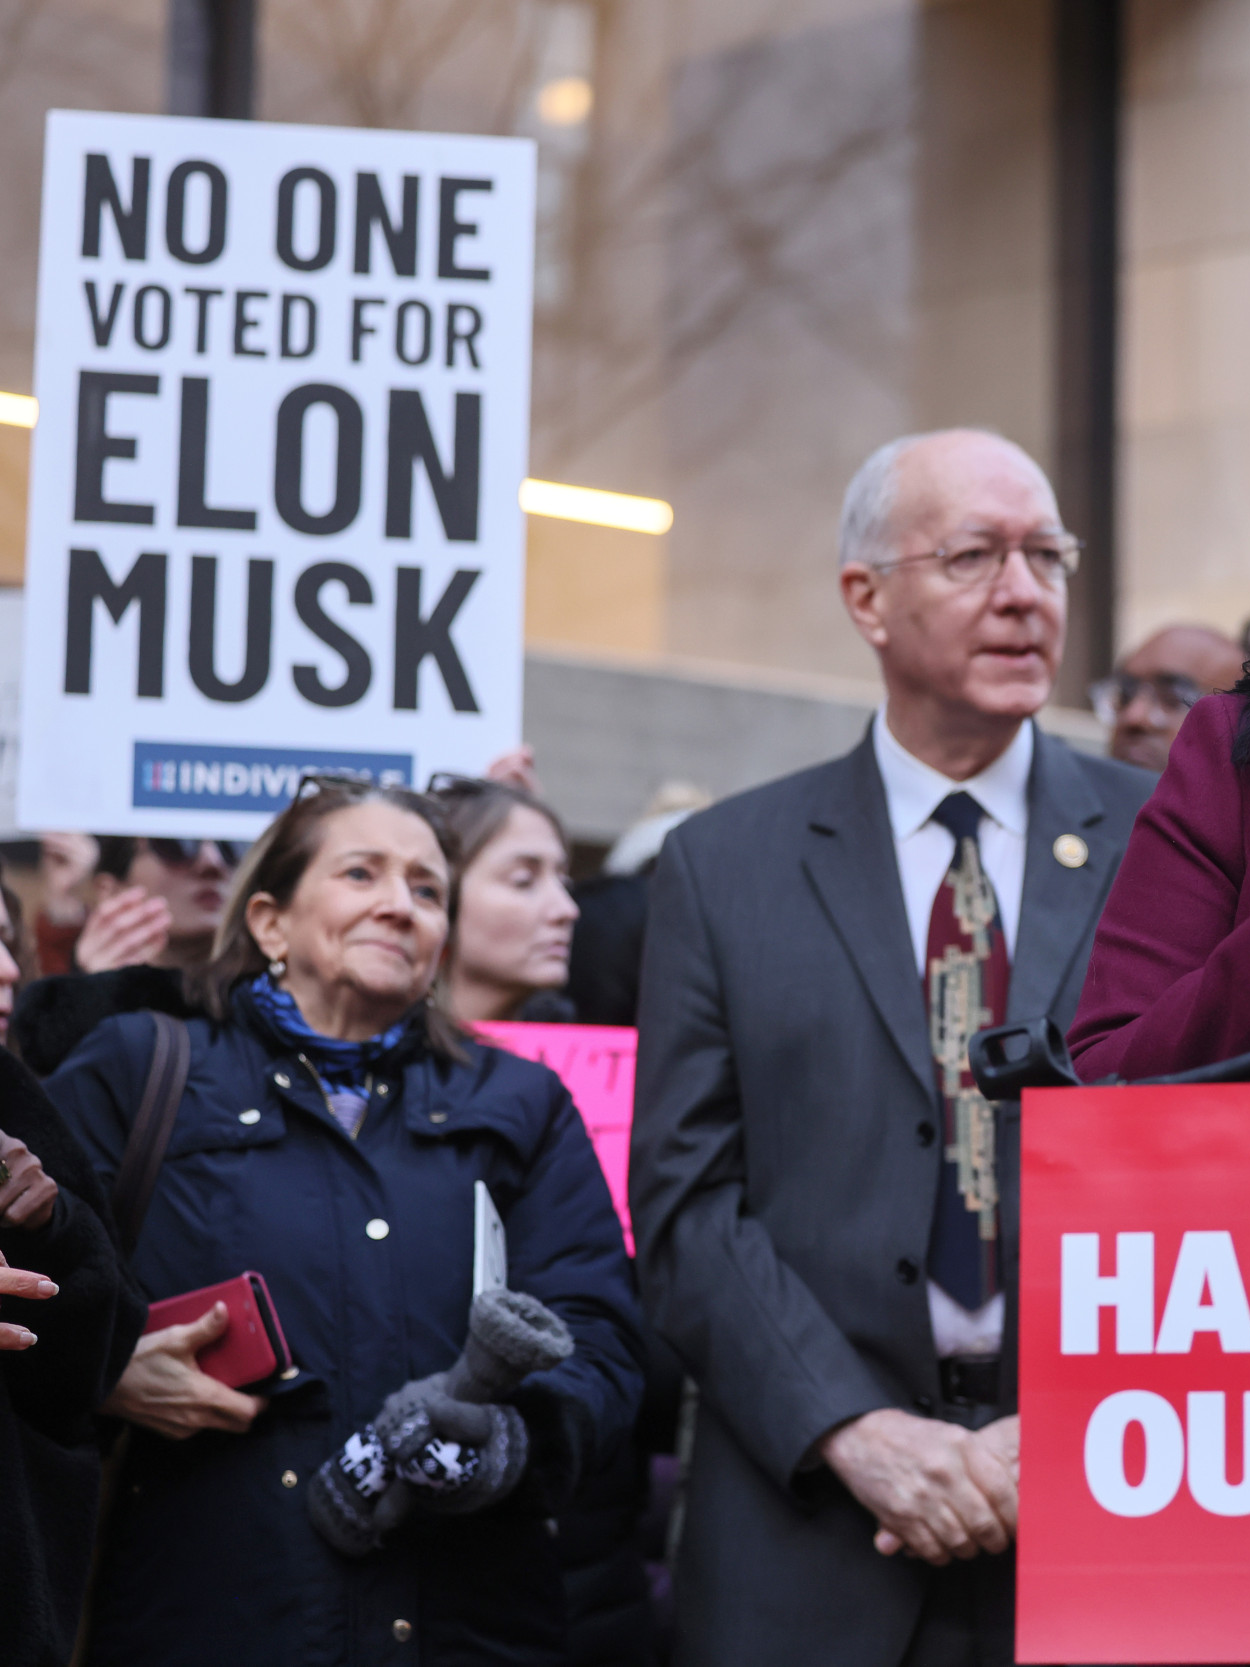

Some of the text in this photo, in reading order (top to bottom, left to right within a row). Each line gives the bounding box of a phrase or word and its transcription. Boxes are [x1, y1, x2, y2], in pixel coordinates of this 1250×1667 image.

[81, 152, 493, 281] NO ONE
[84, 281, 484, 369] VOTED FOR
[73, 370, 481, 543] ELON
[64, 548, 482, 714] MUSK
